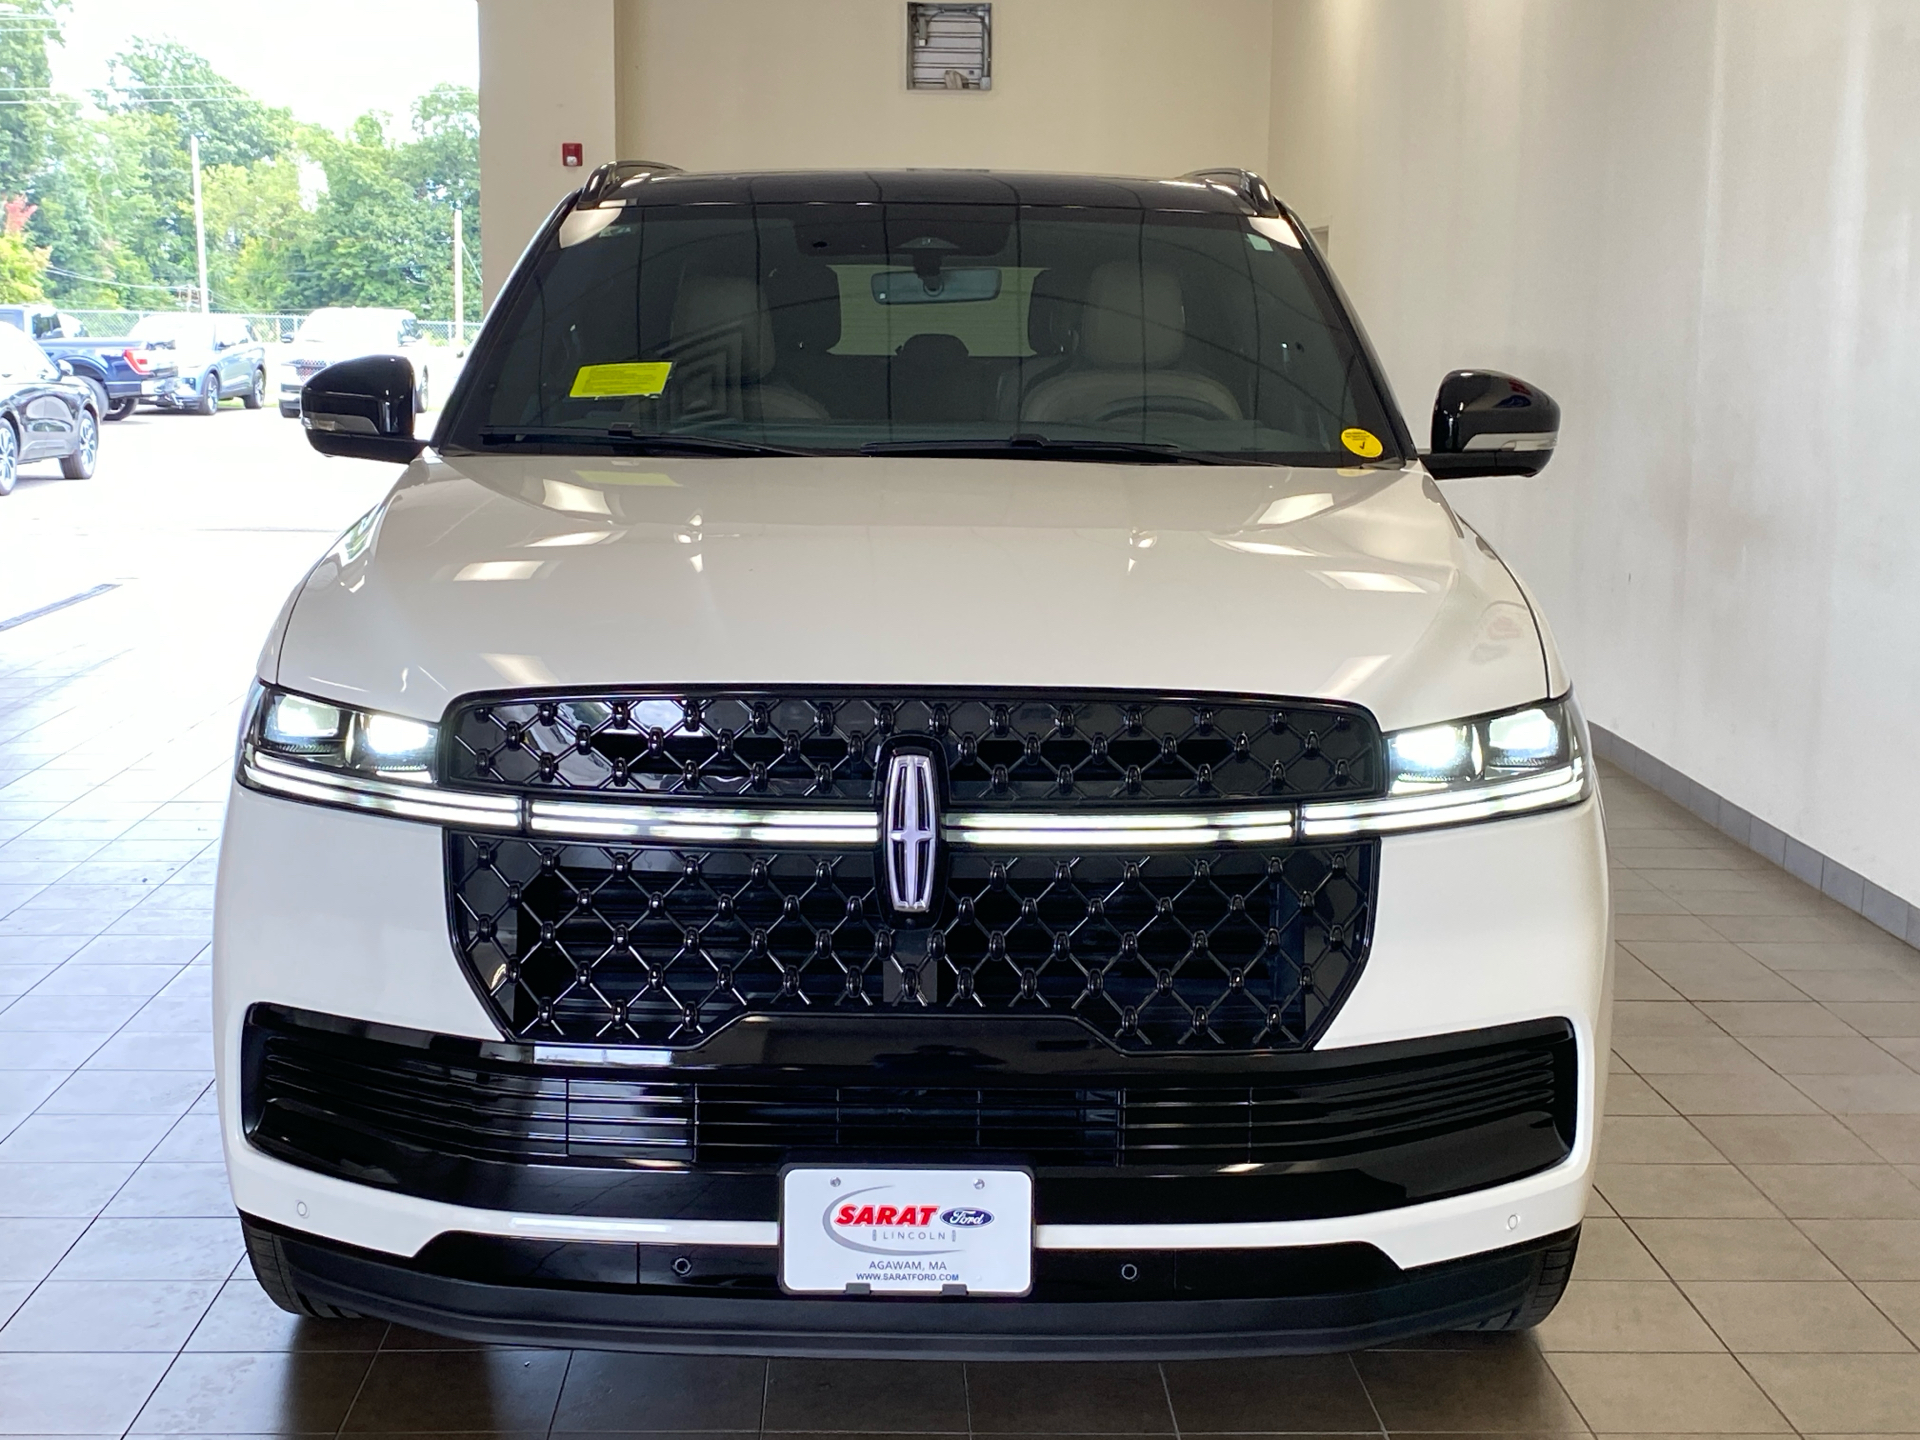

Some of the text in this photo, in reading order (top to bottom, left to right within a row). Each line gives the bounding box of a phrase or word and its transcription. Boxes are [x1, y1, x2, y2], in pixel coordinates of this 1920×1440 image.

[835, 1205, 985, 1227] SARAT Ford
[882, 1231, 946, 1241] LINCOLN
[869, 1260, 947, 1271] AGAWAM, MA
[856, 1272, 960, 1281] WWW.SARATFORD.COM
